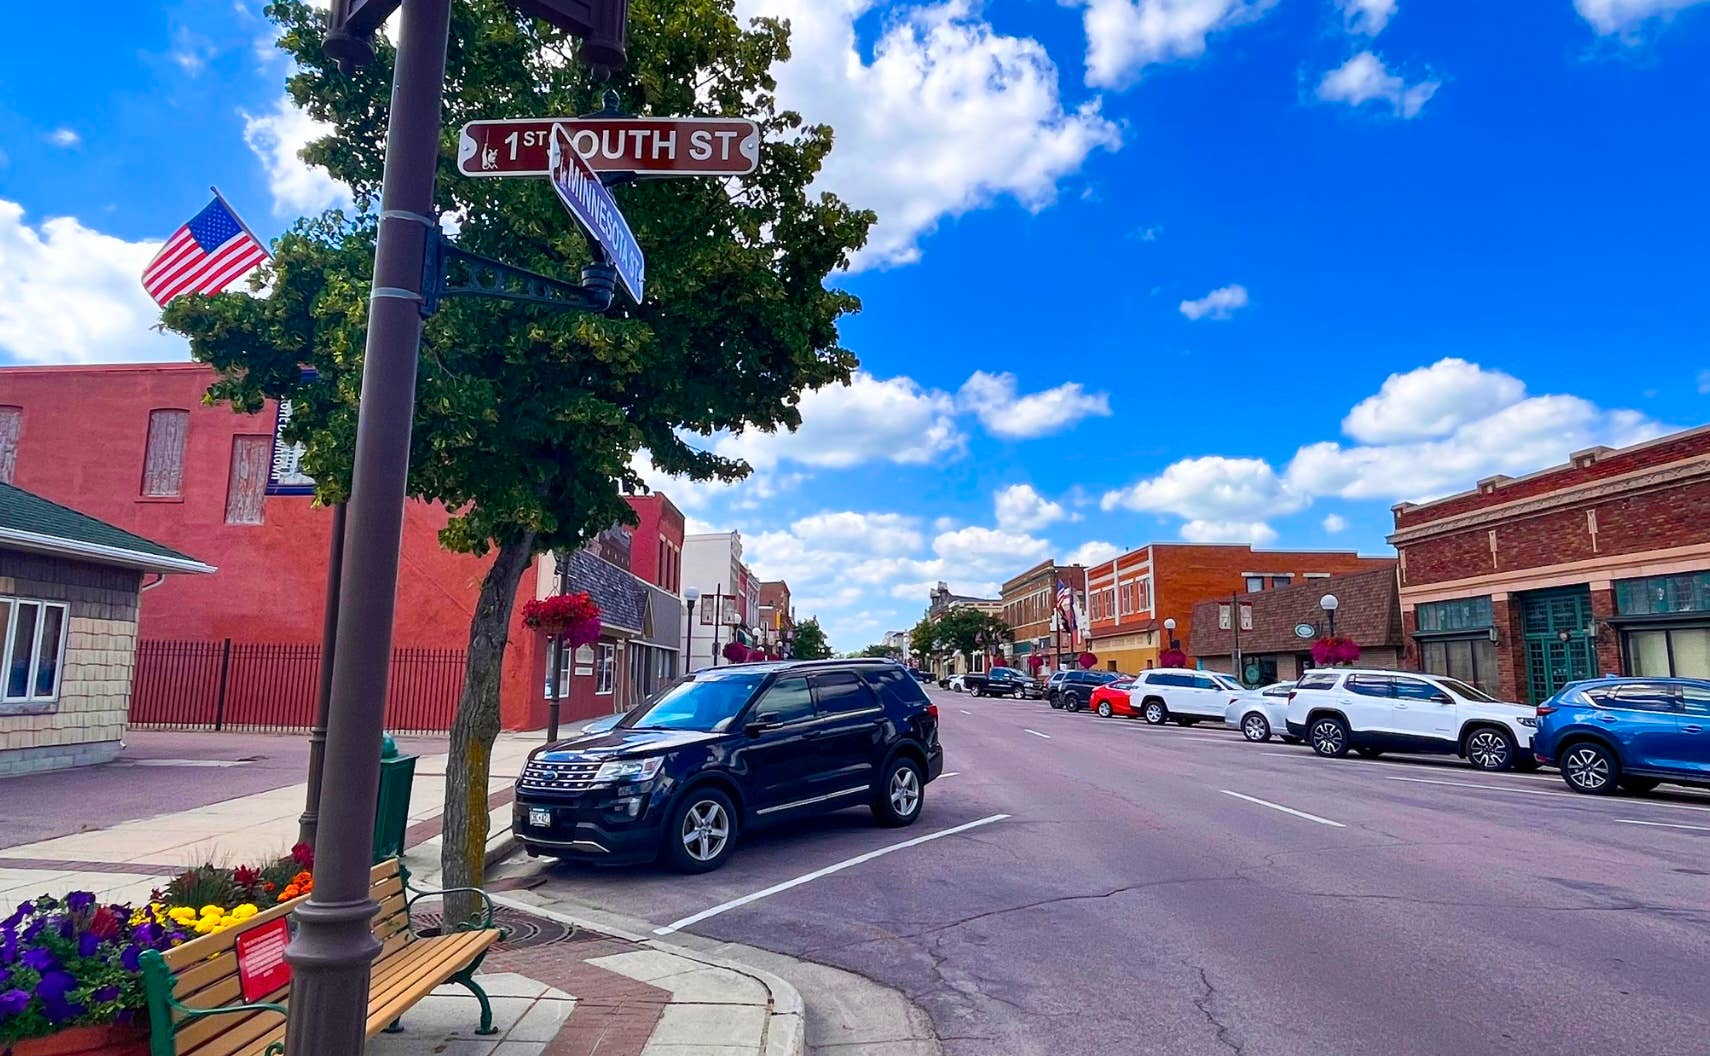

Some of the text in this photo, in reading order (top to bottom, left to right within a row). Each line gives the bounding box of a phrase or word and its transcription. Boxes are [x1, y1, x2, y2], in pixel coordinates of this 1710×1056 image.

[504, 129, 738, 161] 1ST OUTH ST
[568, 157, 628, 270] MINNESOTA
